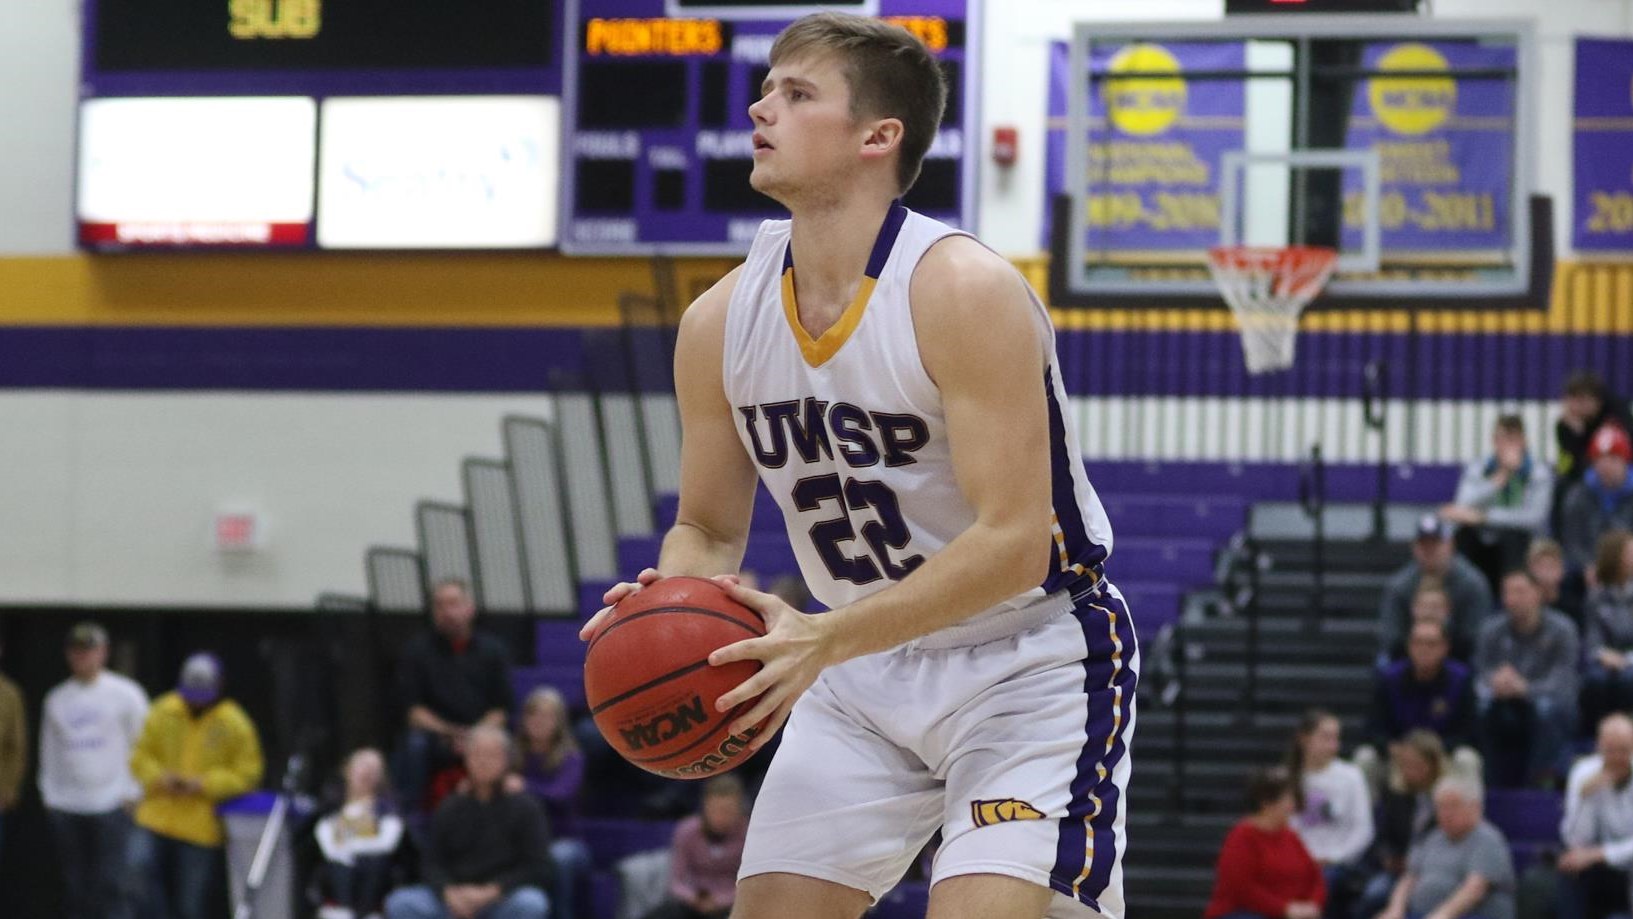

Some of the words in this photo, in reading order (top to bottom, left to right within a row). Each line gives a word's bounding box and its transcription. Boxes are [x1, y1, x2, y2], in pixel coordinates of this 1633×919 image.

[228, 0, 321, 39] SUB
[738, 397, 930, 468] UWSP
[791, 472, 926, 585] 22
[618, 695, 708, 751] NCAA
